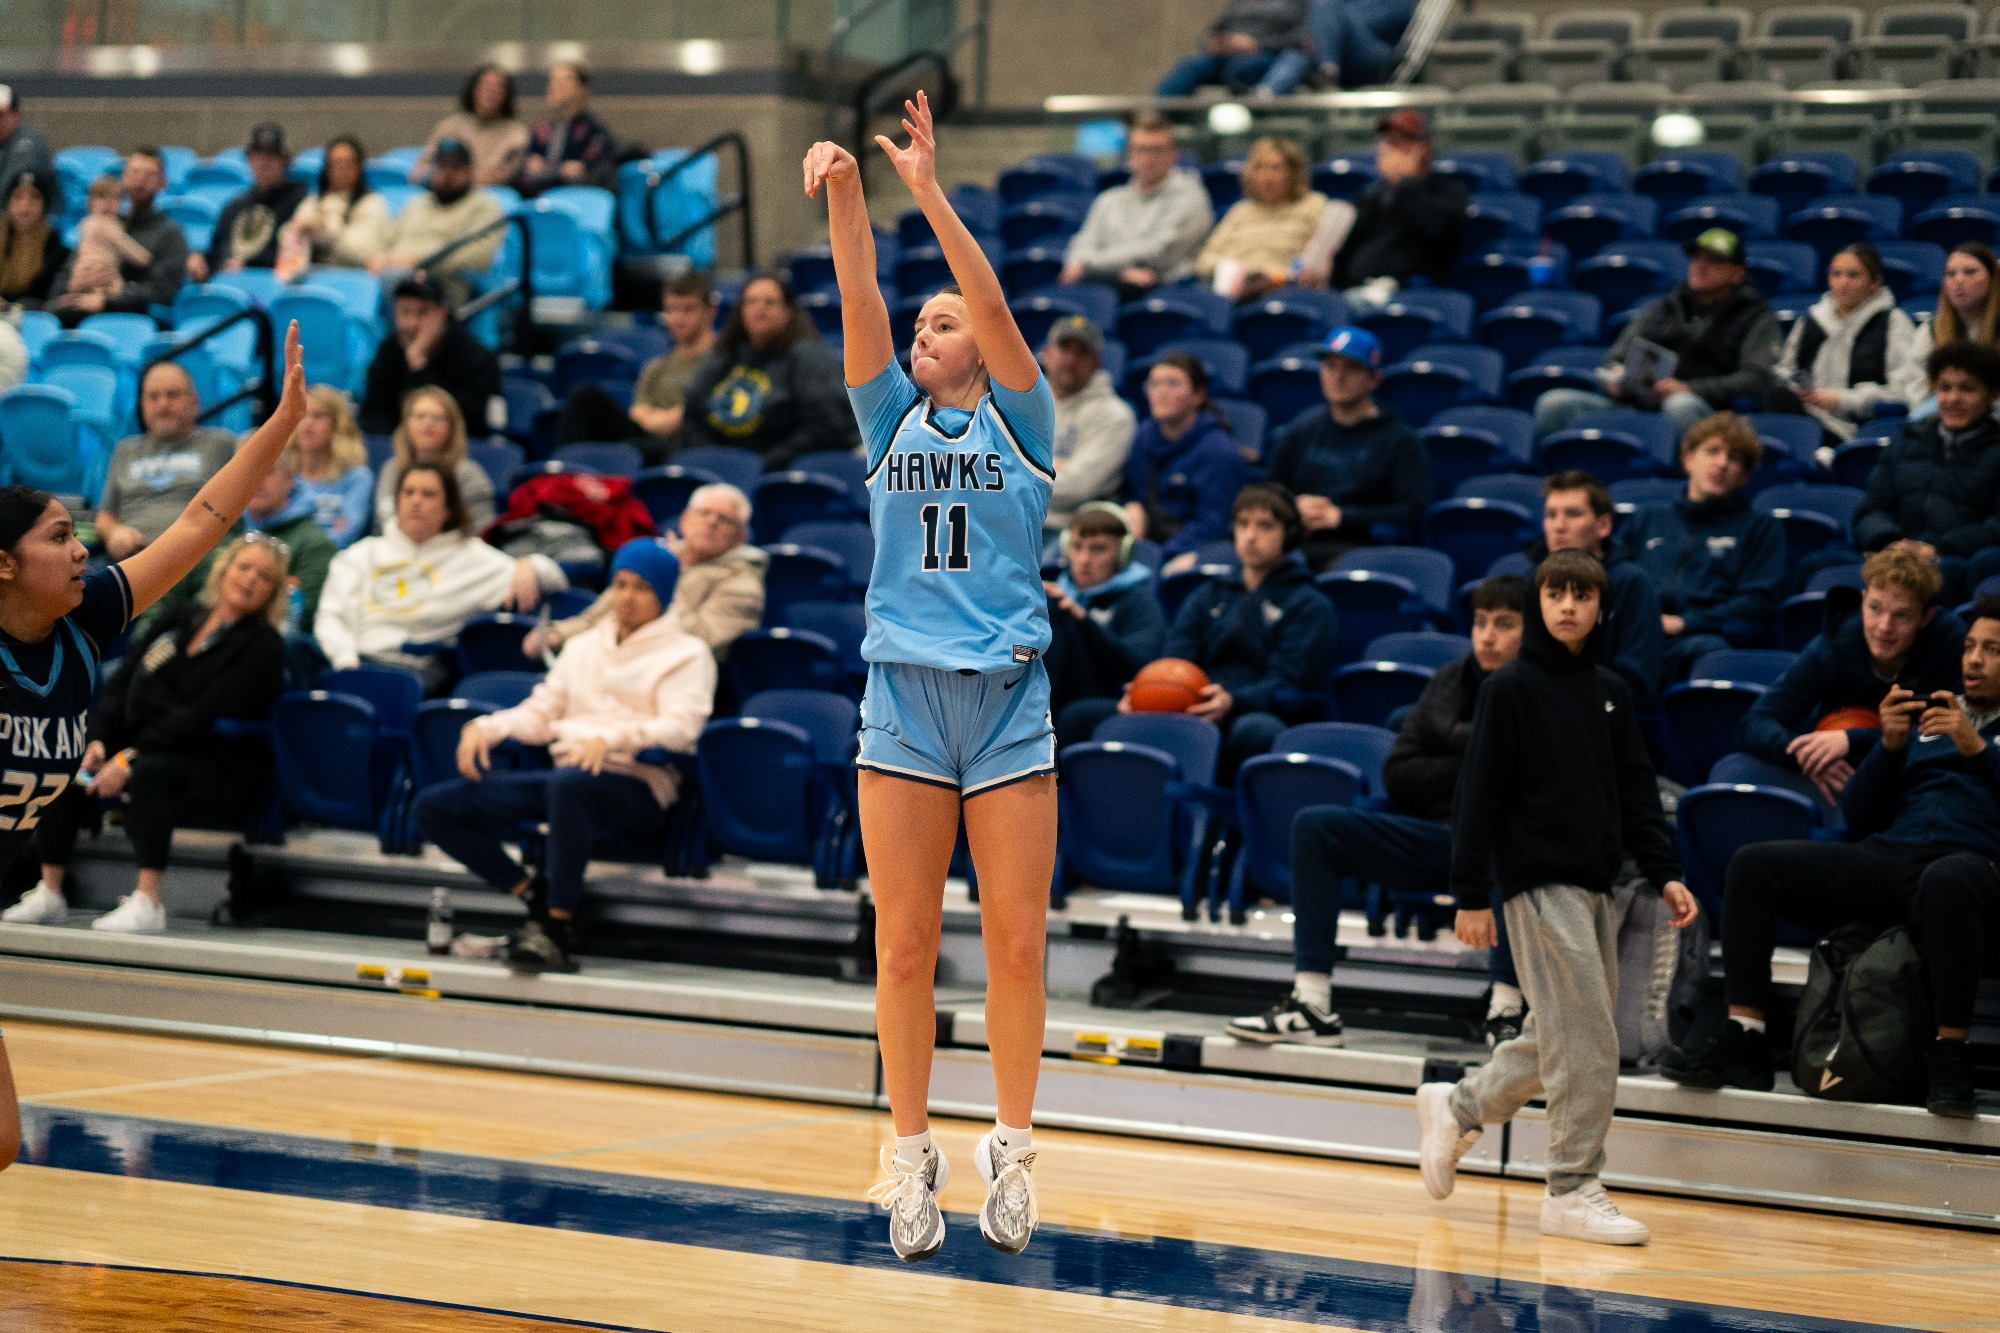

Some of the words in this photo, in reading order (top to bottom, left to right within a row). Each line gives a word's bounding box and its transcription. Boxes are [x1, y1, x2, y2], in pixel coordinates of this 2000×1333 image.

[886, 451, 1006, 493] HAWKS
[919, 503, 971, 573] 11
[0, 709, 88, 760] POKAN
[0, 769, 71, 831] 22
